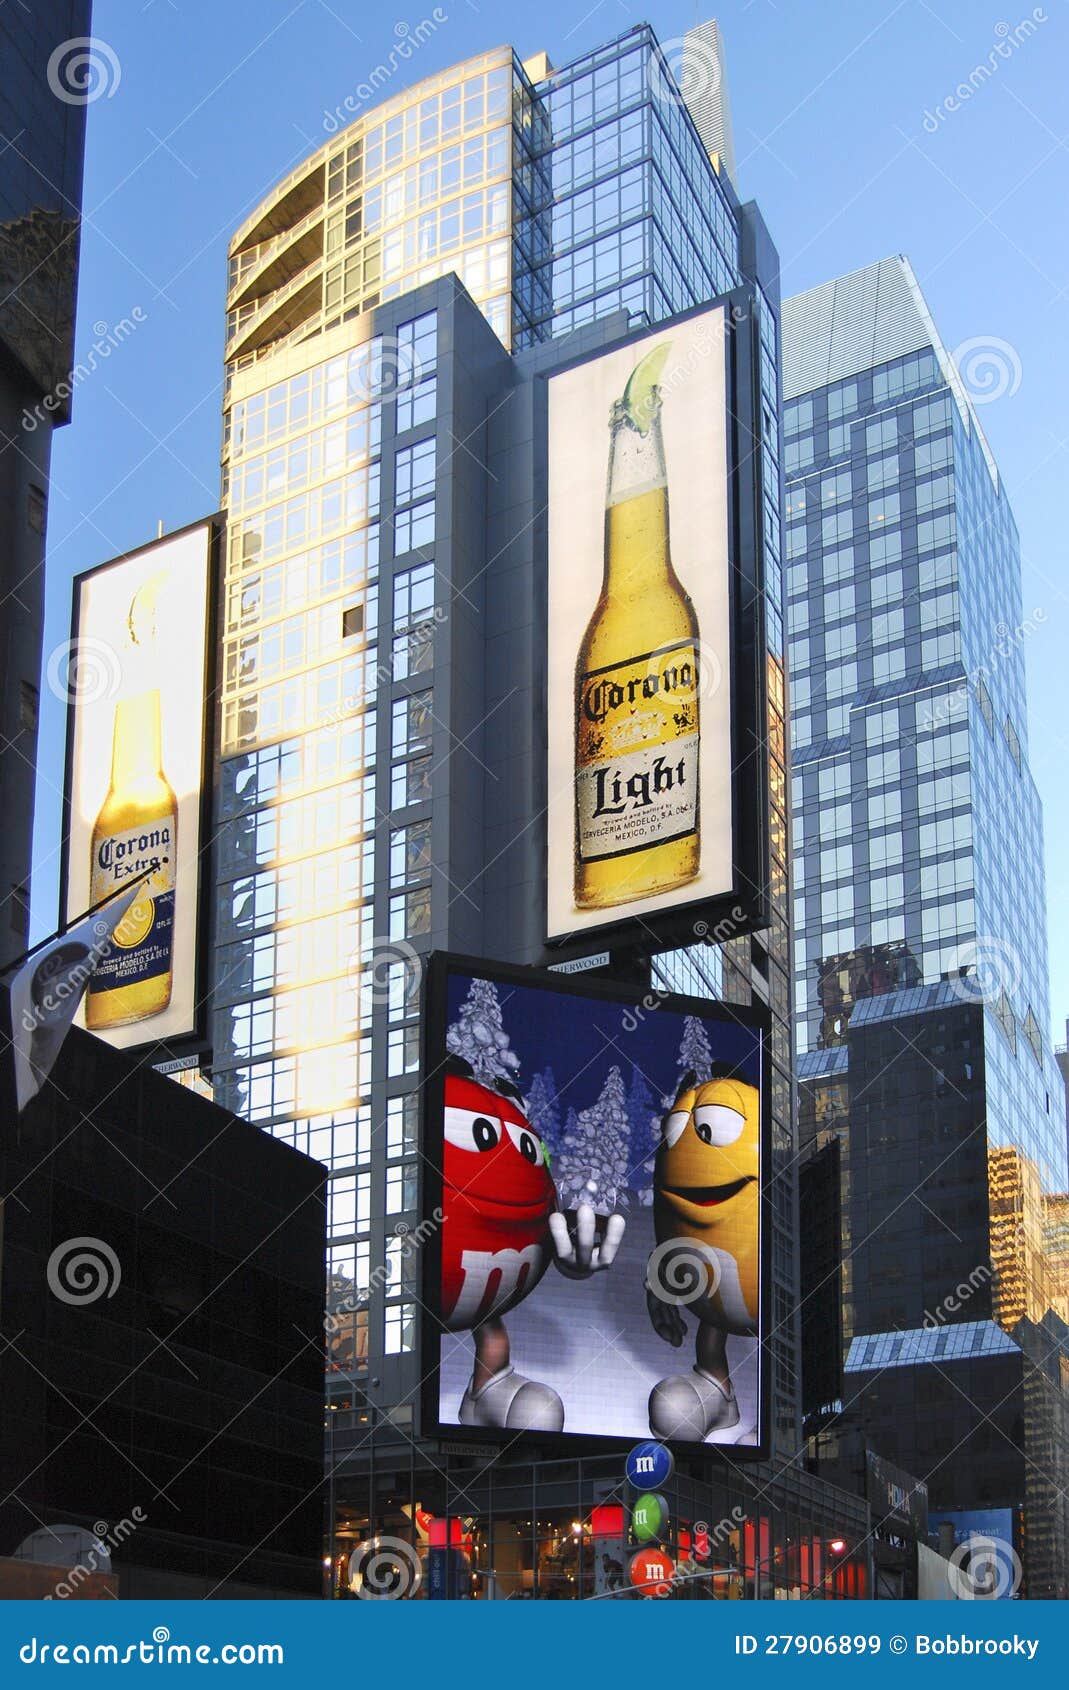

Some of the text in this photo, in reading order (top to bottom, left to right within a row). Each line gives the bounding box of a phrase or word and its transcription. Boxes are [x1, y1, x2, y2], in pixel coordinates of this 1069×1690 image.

[583, 662, 699, 723] Corona
[590, 756, 686, 820] Light
[98, 826, 171, 871] Corona
[636, 1455, 656, 1473] m
[635, 1508, 648, 1525] m
[645, 1563, 666, 1580] m
